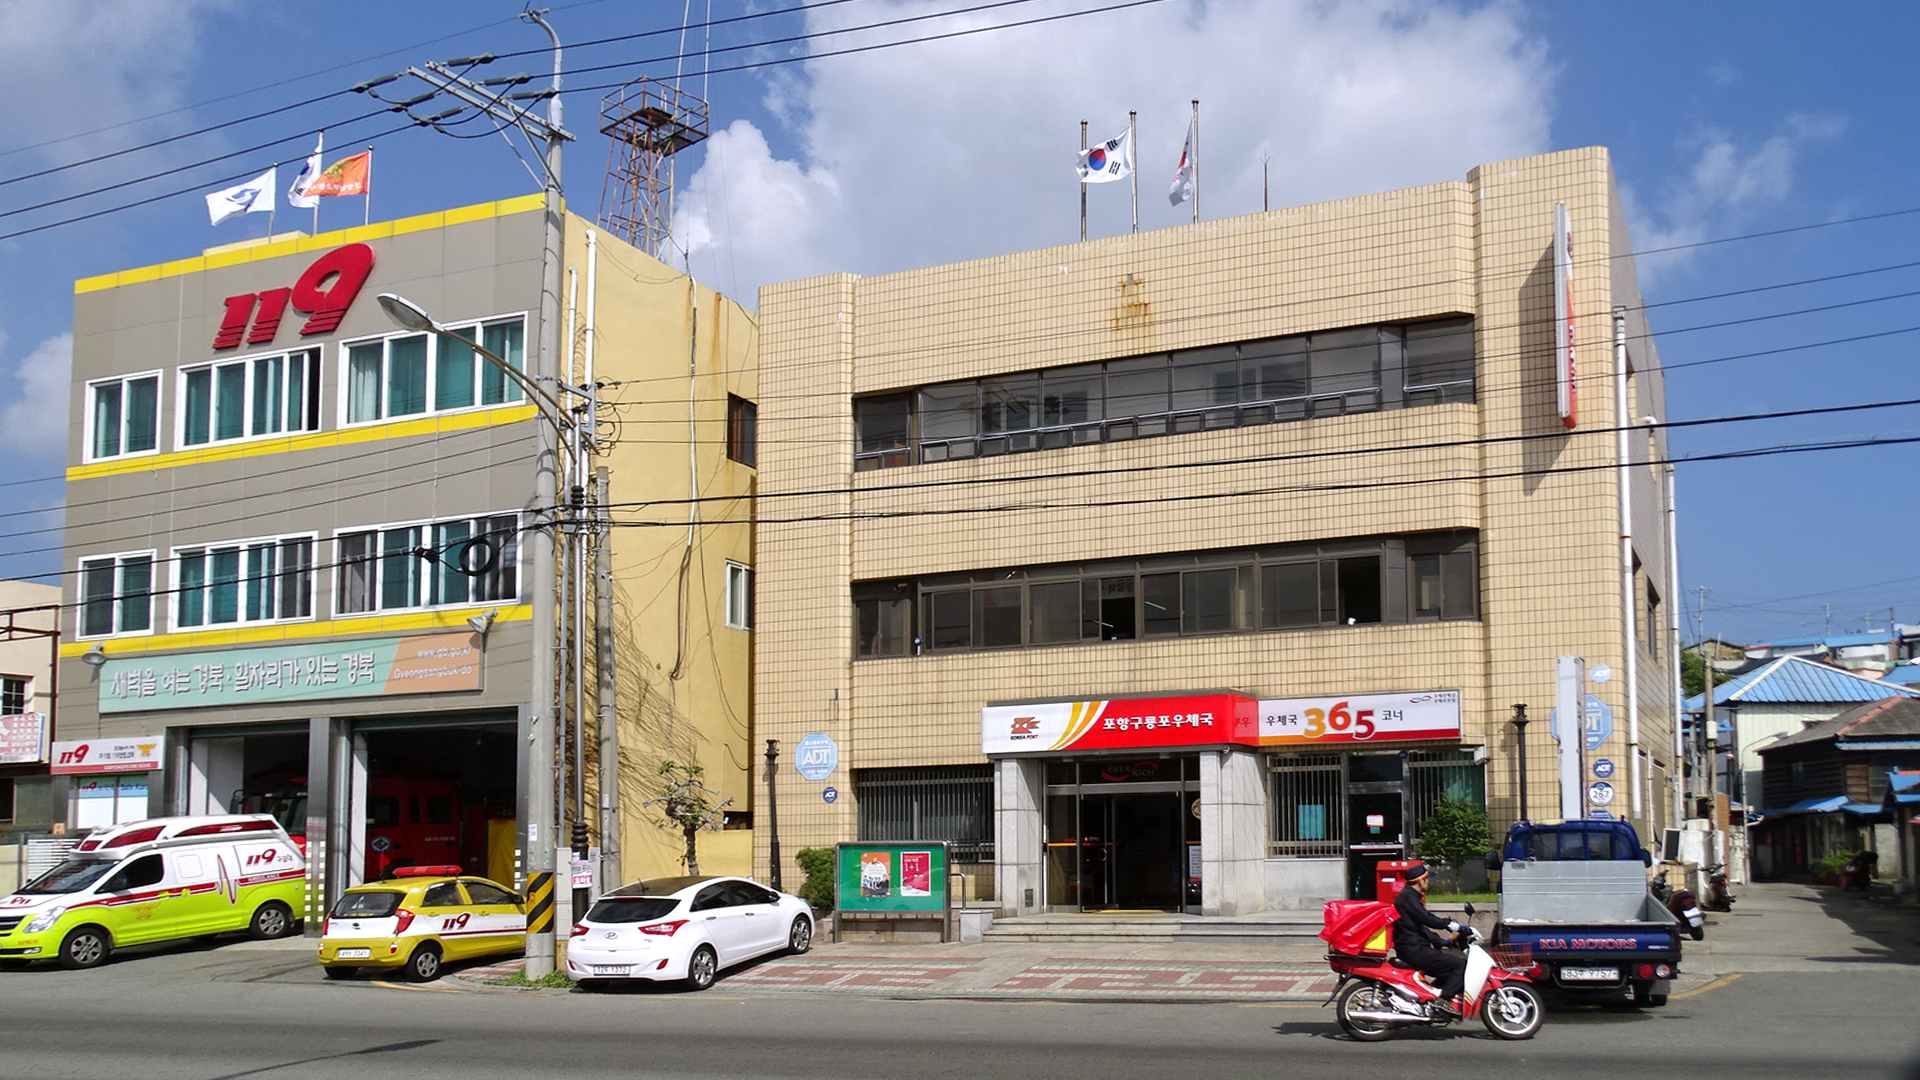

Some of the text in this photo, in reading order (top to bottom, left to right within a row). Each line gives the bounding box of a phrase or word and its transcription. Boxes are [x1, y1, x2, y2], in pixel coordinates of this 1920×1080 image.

[212, 243, 376, 350] 119
[417, 646, 472, 660] www.gb.go.kr
[111, 652, 376, 698] 새벽을 여는 경북 일자리가 있는 경북
[393, 664, 473, 680] Gyeongsangbuk-do
[1102, 712, 1214, 731] 포항구룡포우체국
[1266, 701, 1403, 740] 우체국 365 코너
[59, 743, 90, 764] 119
[802, 749, 831, 765] ADT
[1107, 764, 1130, 774] EVER
[1131, 768, 1155, 777] RICH
[1595, 764, 1612, 773] ADT
[1592, 790, 1610, 799] 267
[246, 848, 277, 866] 119
[442, 912, 472, 930] 119
[1539, 938, 1638, 949] KIA MOTORS
